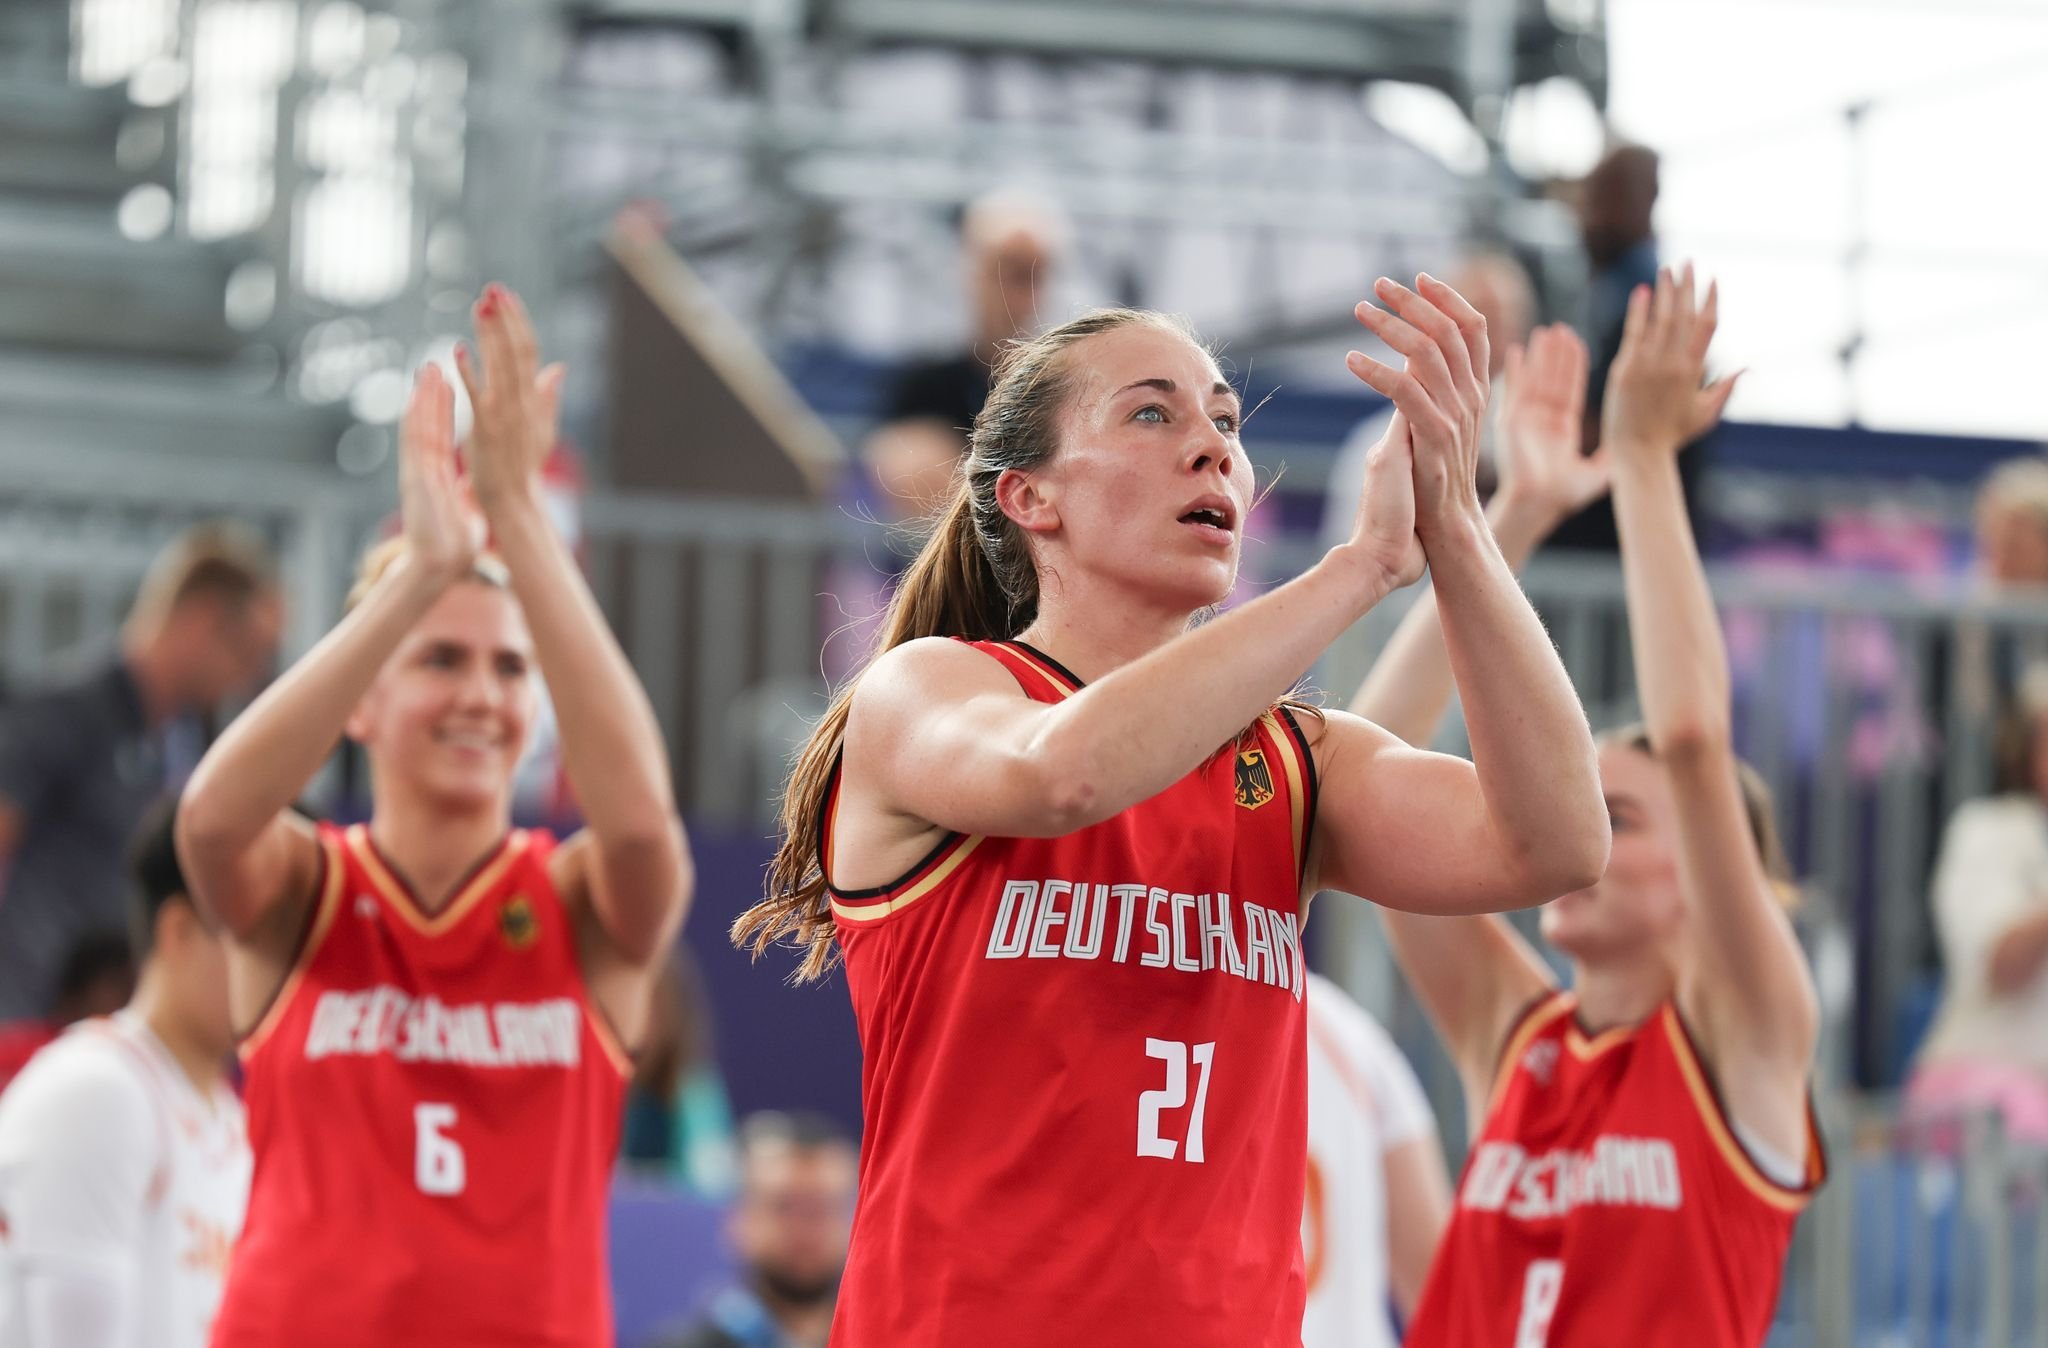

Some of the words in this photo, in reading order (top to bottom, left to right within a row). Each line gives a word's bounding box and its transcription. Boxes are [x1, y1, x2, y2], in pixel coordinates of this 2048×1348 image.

[986, 879, 1304, 1003] DEUTSCHLAN
[414, 1103, 466, 1195] 6
[1137, 1037, 1216, 1163] 21
